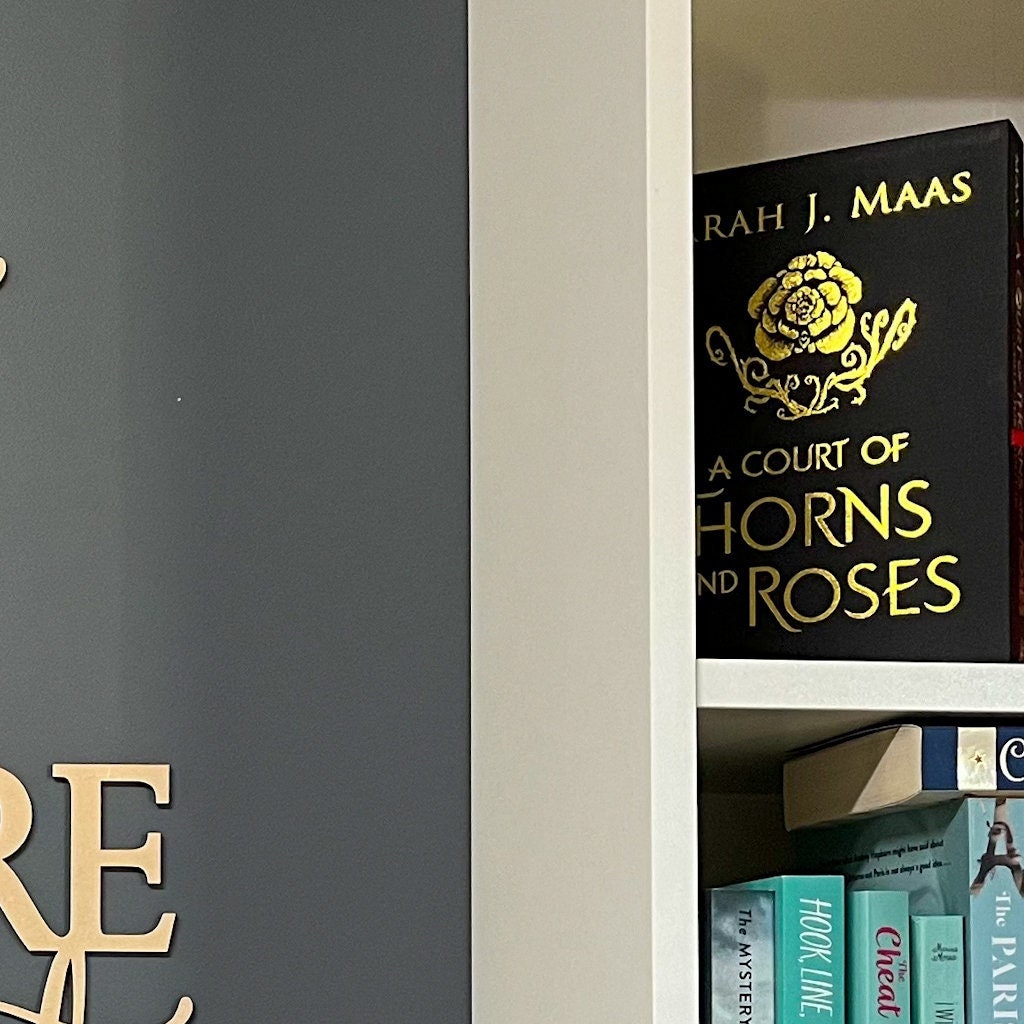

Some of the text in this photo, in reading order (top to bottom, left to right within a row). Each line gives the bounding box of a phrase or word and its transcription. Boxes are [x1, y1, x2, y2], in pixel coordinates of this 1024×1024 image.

[694, 203, 785, 242] RAH
[804, 192, 831, 234] J.
[850, 171, 973, 219] MAAS
[708, 432, 910, 481] A COURT OF
[697, 554, 961, 633] ND ROSES
[738, 909, 752, 936] The
[798, 898, 832, 963] HOOK,
[995, 891, 1011, 927] The
[799, 967, 833, 1018] LINE,
[875, 926, 902, 1019] Cheat
[898, 960, 907, 982] The
